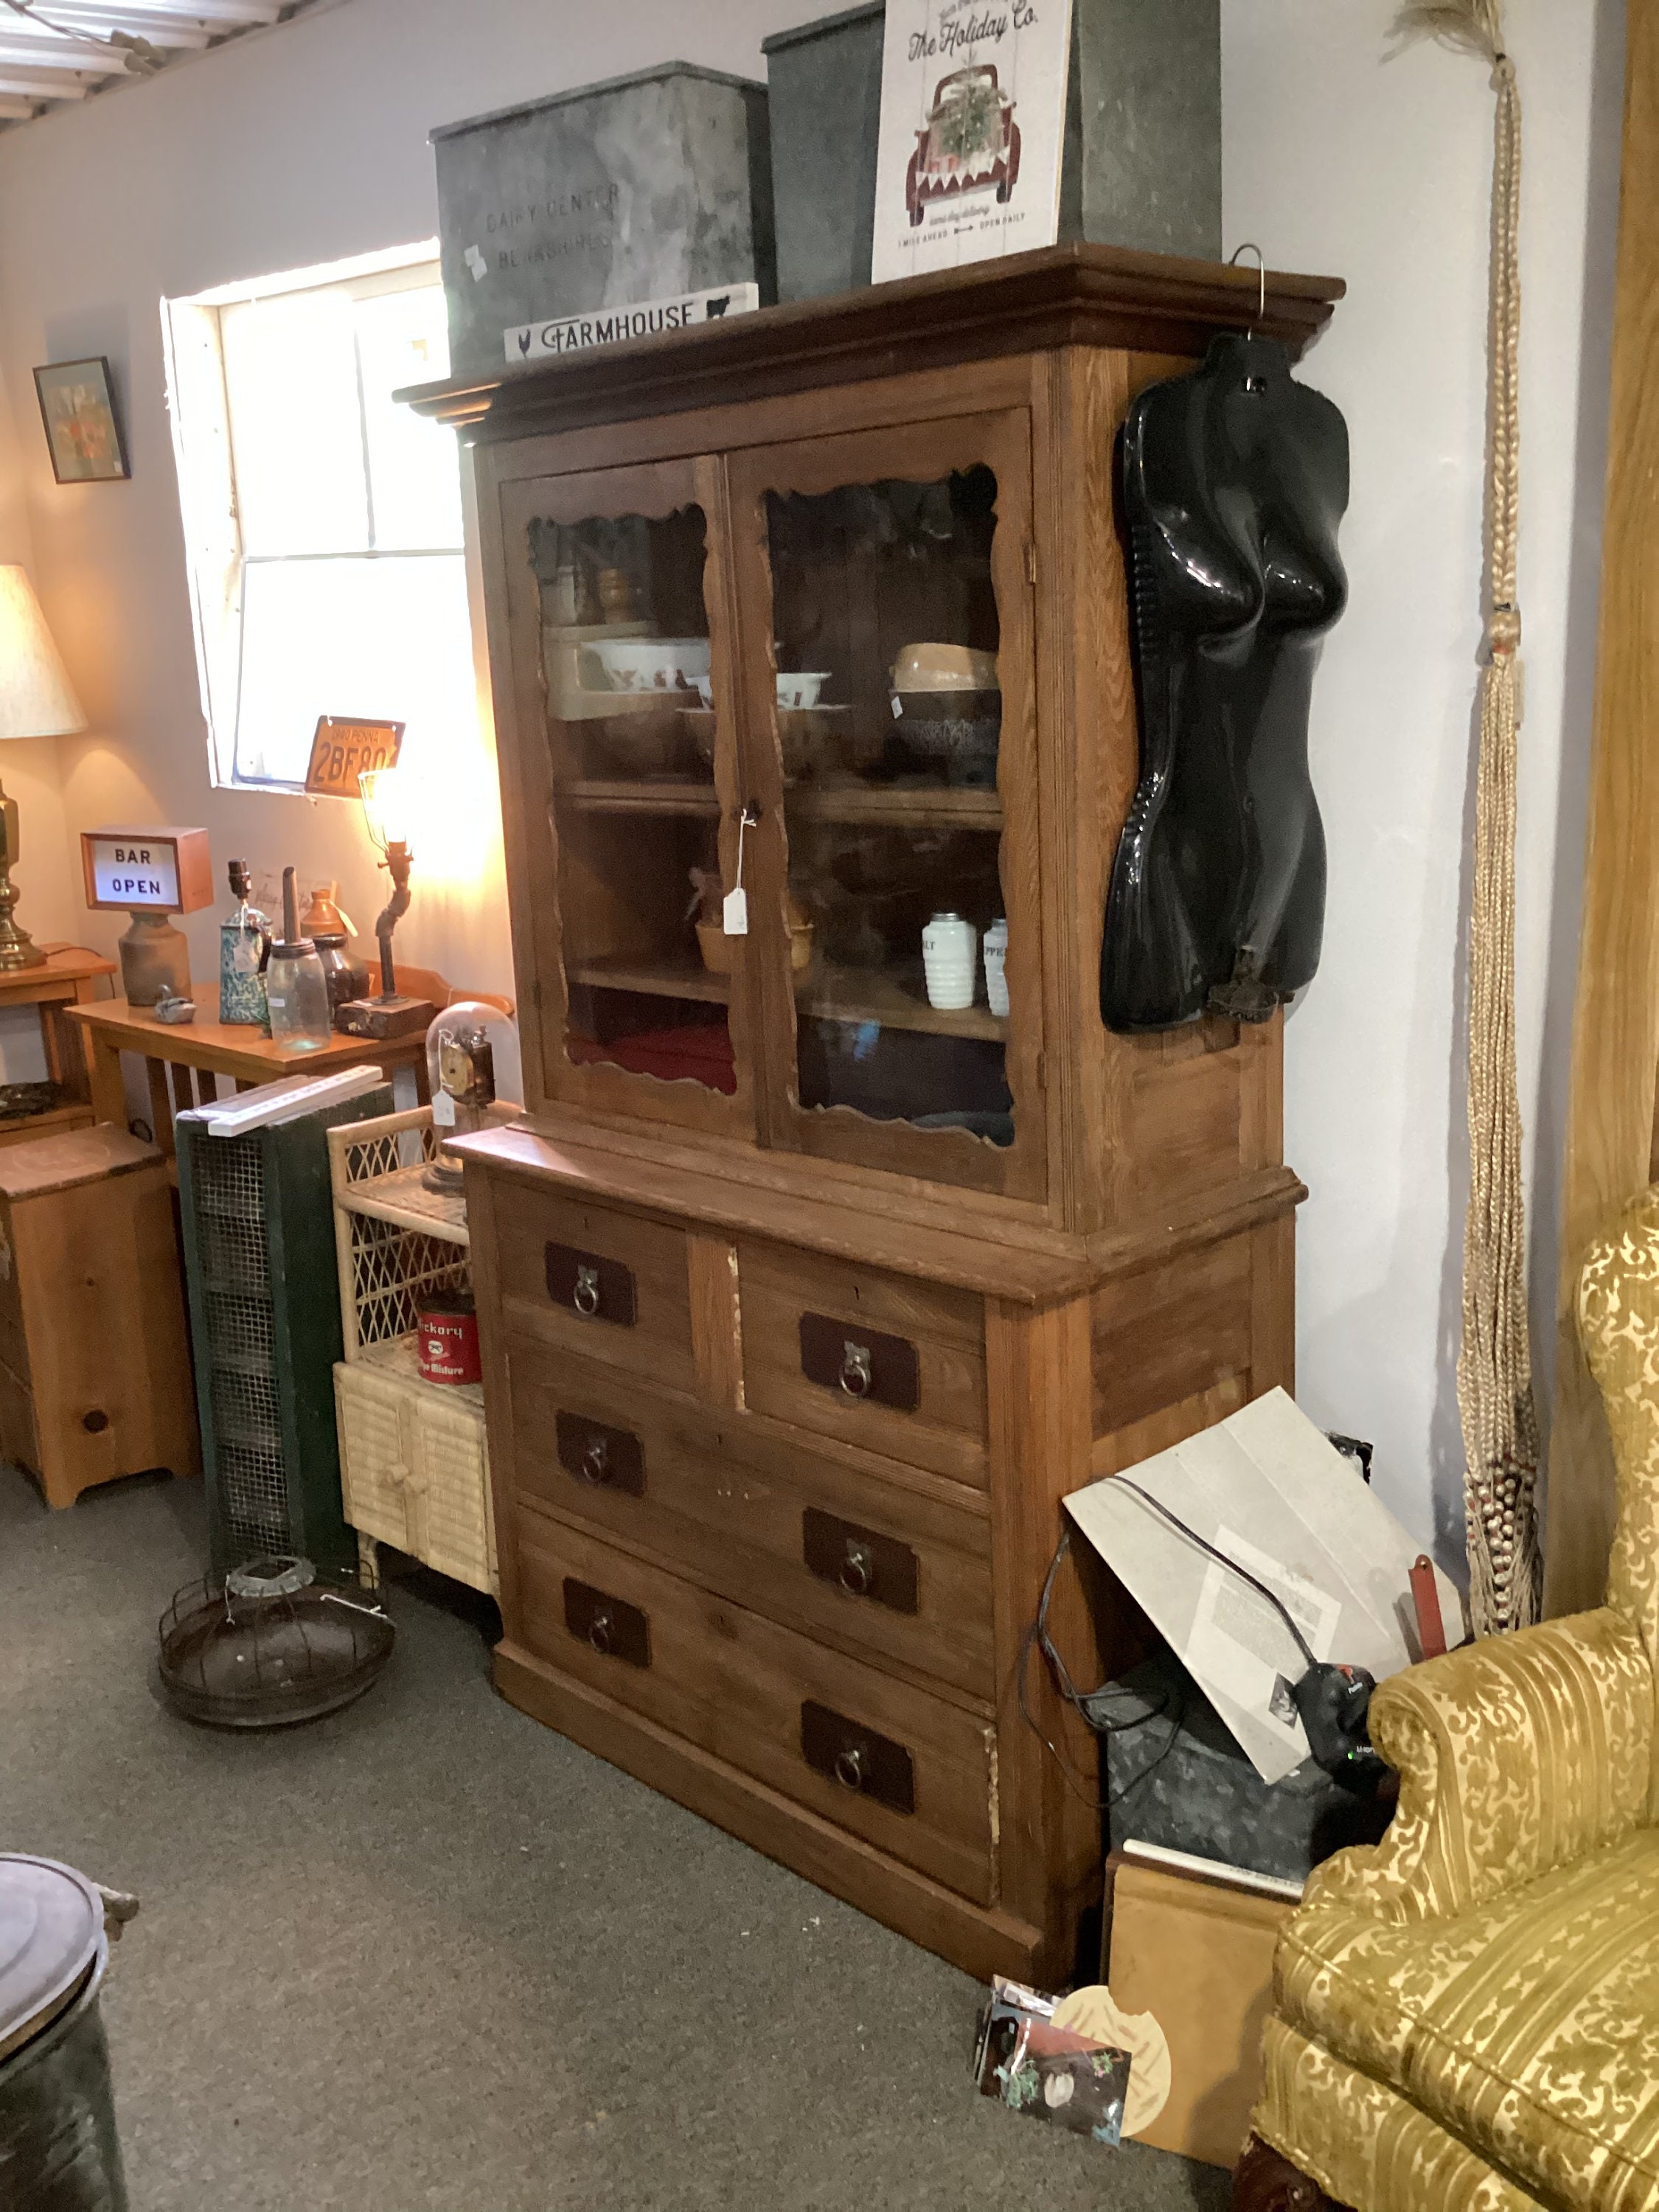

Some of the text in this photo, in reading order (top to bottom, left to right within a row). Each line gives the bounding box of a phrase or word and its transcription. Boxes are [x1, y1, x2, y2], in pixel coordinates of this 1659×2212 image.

[908, 30, 936, 61] The
[939, 10, 1008, 58] Holiday
[1012, 0, 1038, 29] Co.
[979, 218, 1001, 230] OPEN
[1003, 212, 1026, 224] DAILY
[541, 302, 693, 354] FARMHOUSE
[115, 849, 151, 865] BAR
[112, 878, 161, 894] OPEN
[431, 1363, 464, 1375] Mixture
